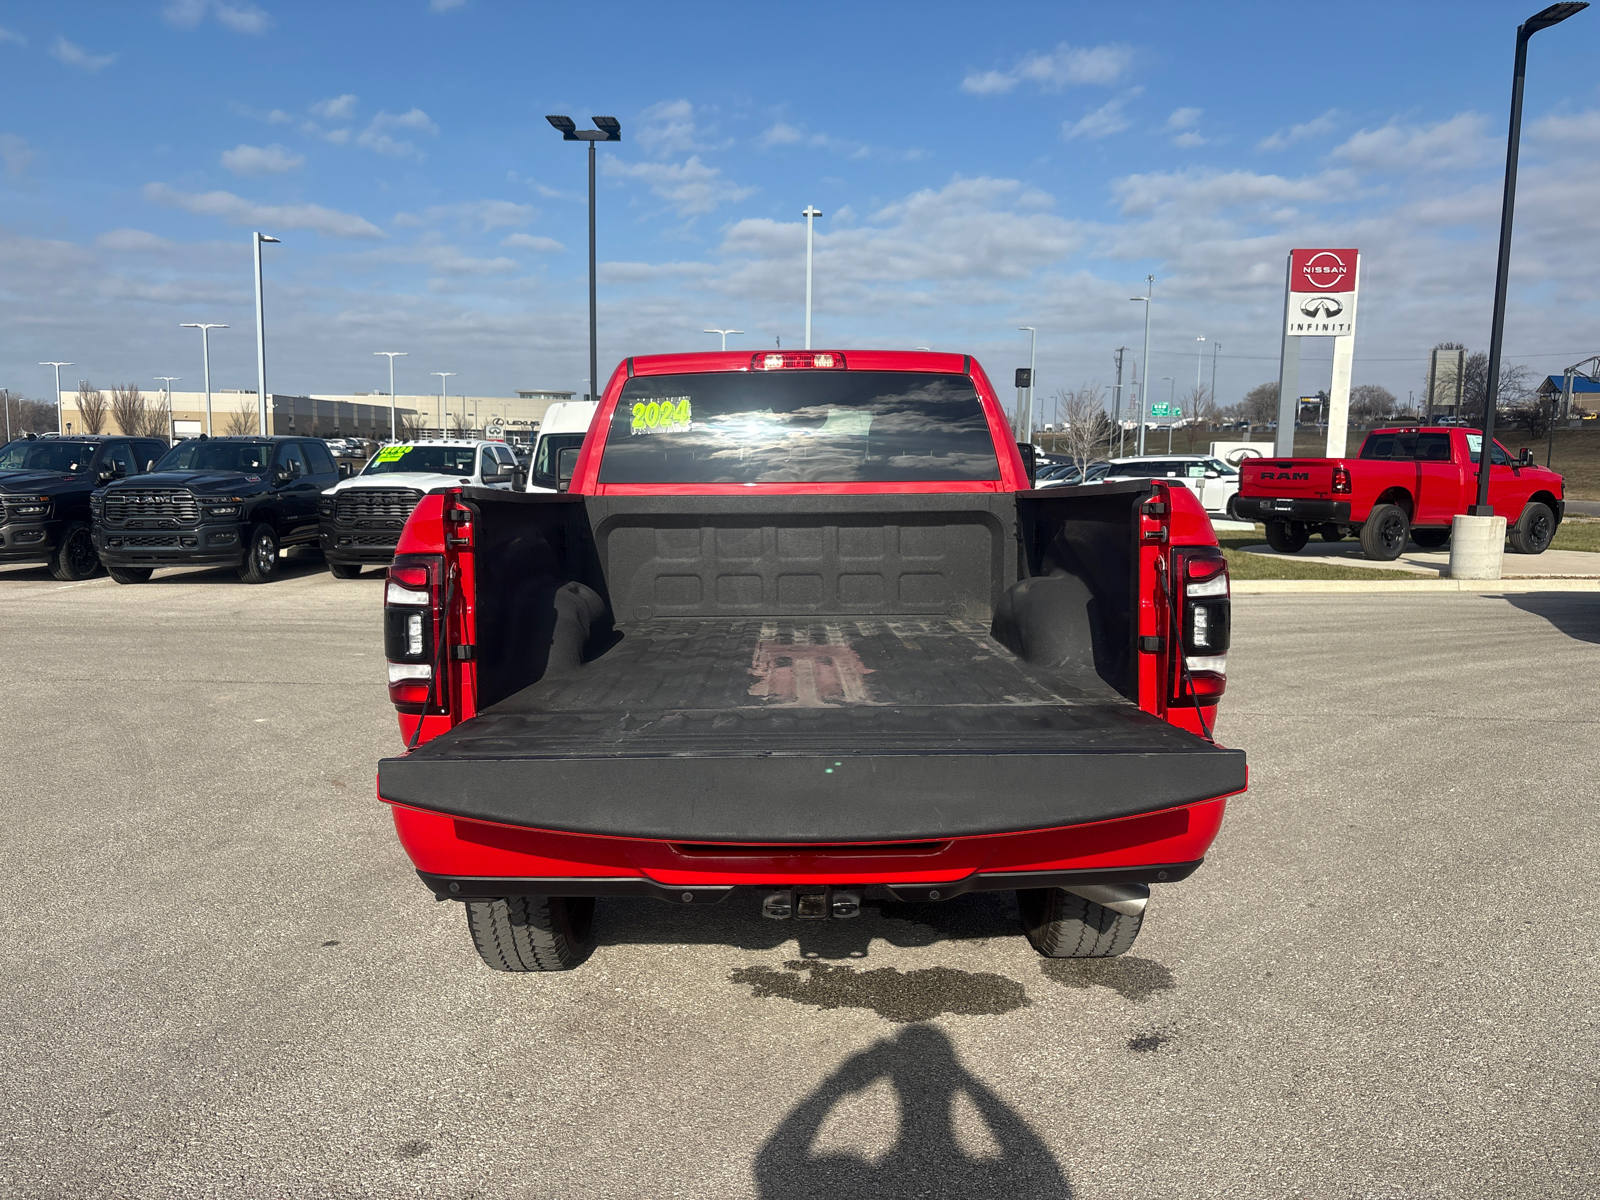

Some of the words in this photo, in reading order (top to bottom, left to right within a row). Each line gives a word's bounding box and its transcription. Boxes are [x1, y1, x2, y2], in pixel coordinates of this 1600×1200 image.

[1303, 266, 1347, 274] NISSAN
[1290, 323, 1351, 332] INFINITI
[631, 399, 690, 429] 2024
[1260, 472, 1309, 480] RAM
